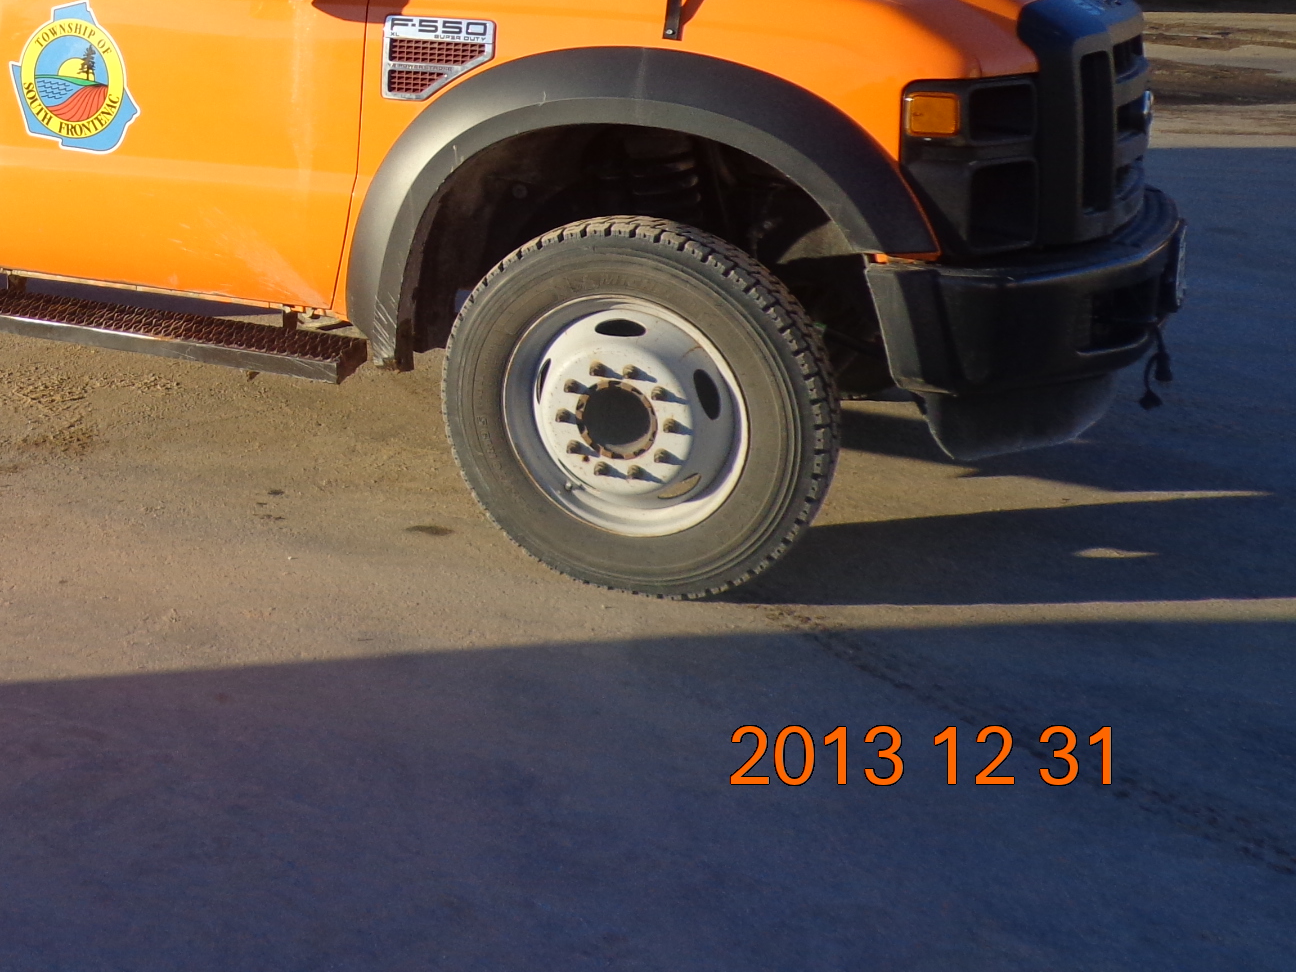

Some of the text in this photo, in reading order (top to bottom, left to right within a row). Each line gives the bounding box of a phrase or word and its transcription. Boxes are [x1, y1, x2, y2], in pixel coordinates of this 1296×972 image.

[34, 22, 112, 55] TOWNSHIP OF
[390, 17, 488, 36] F-550
[23, 81, 120, 137] SOUTH FRONTENAC
